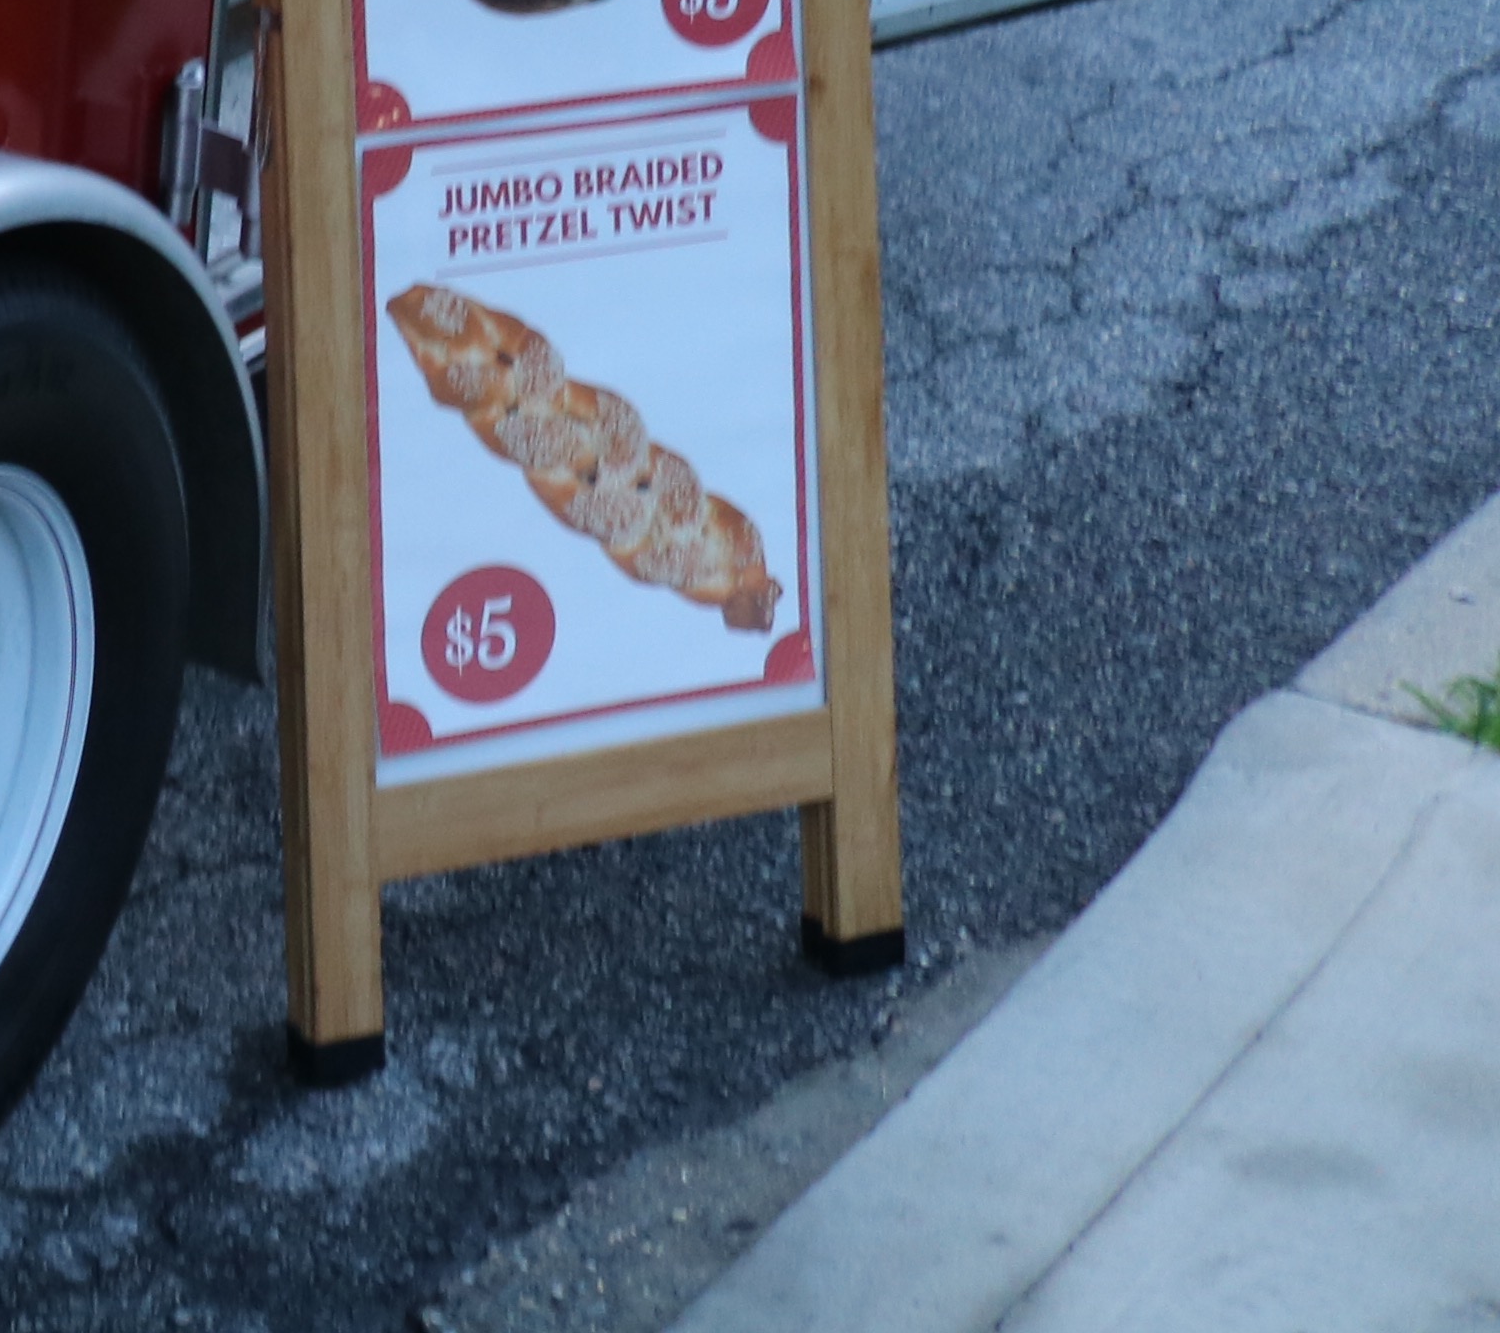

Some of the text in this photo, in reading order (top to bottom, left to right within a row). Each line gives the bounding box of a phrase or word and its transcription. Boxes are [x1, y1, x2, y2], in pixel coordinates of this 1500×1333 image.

[436, 151, 724, 221] JUMBO BRAIDED
[446, 189, 718, 258] PRETZEL TWIST
[444, 594, 518, 677] $5
